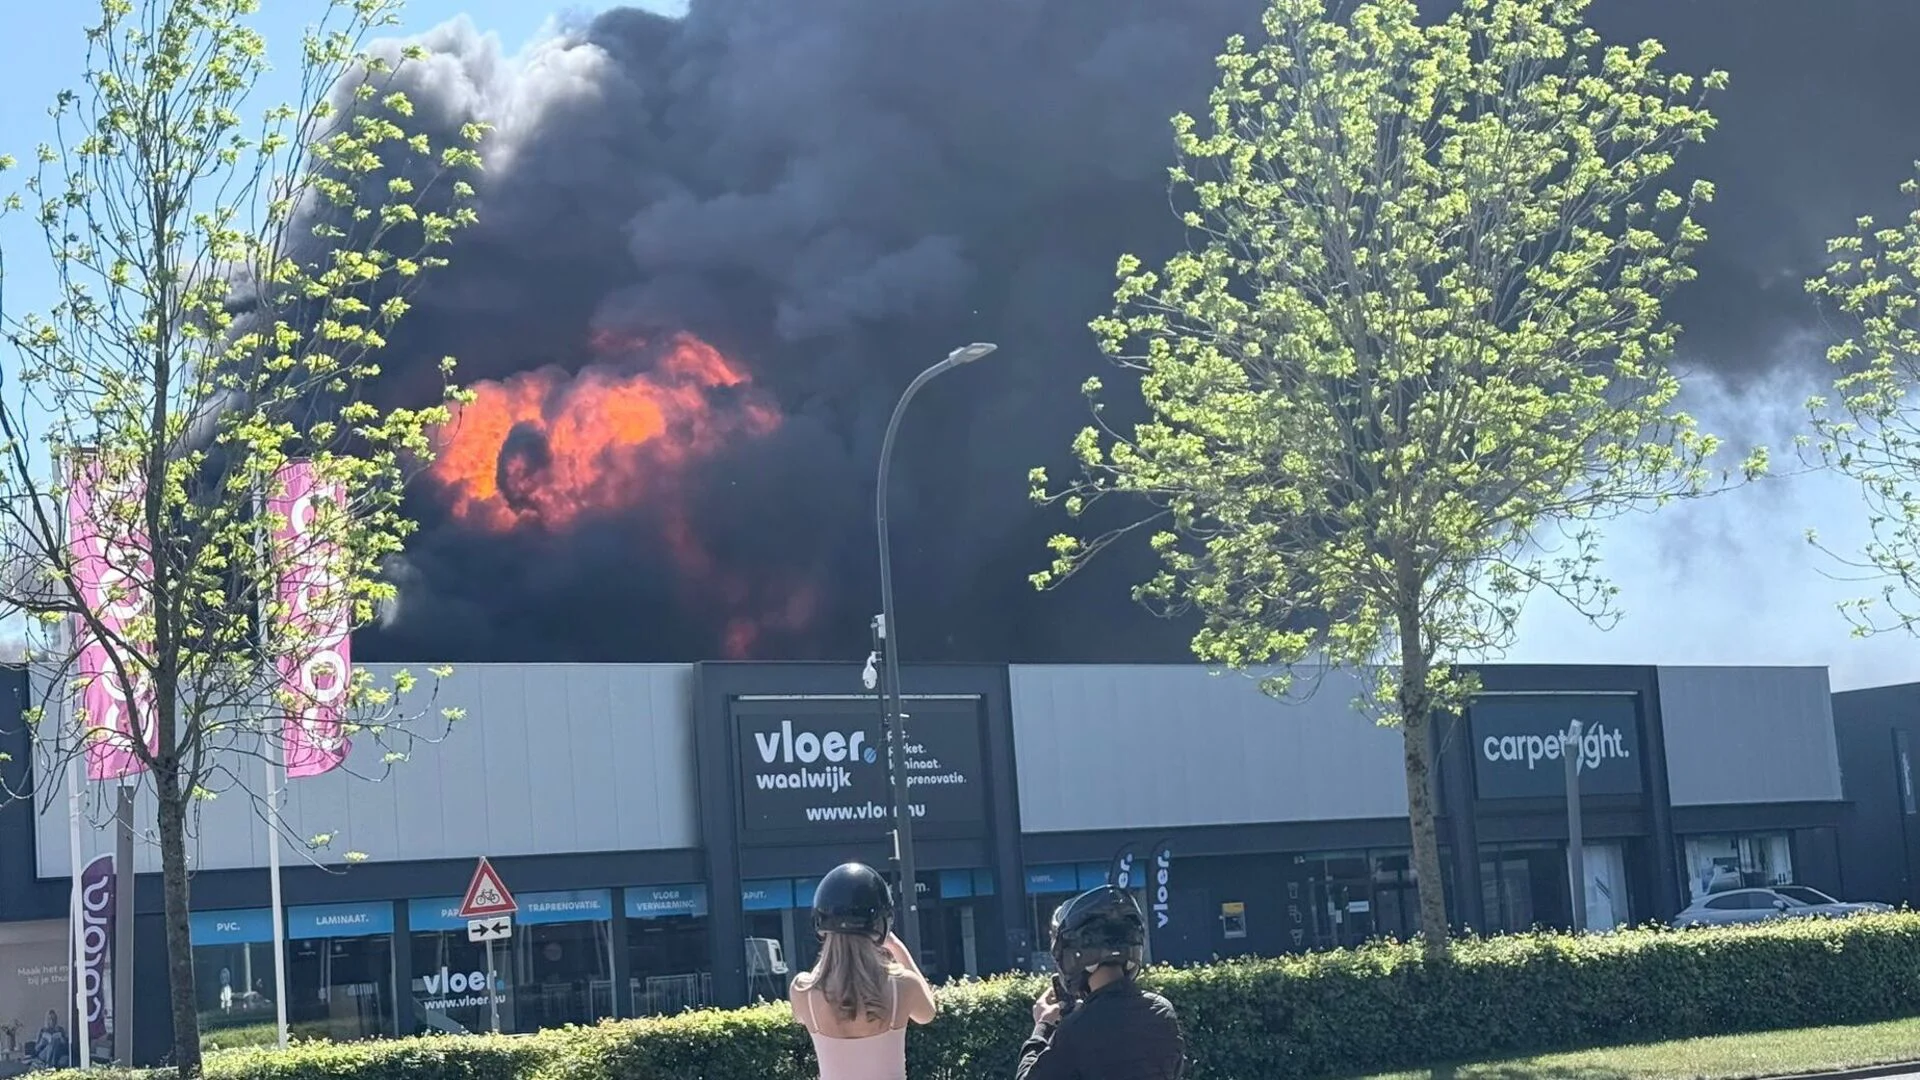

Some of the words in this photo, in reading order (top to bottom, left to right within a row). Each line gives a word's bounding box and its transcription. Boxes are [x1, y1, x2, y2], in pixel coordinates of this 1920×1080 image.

[1484, 720, 1629, 776] carpetight.
[756, 767, 852, 793] waalwijk
[1153, 850, 1171, 928] vloer.
[528, 901, 601, 913] TRAPRENOVATIE.
[216, 922, 241, 932] PVC.
[316, 914, 370, 926] LAMINAAT.
